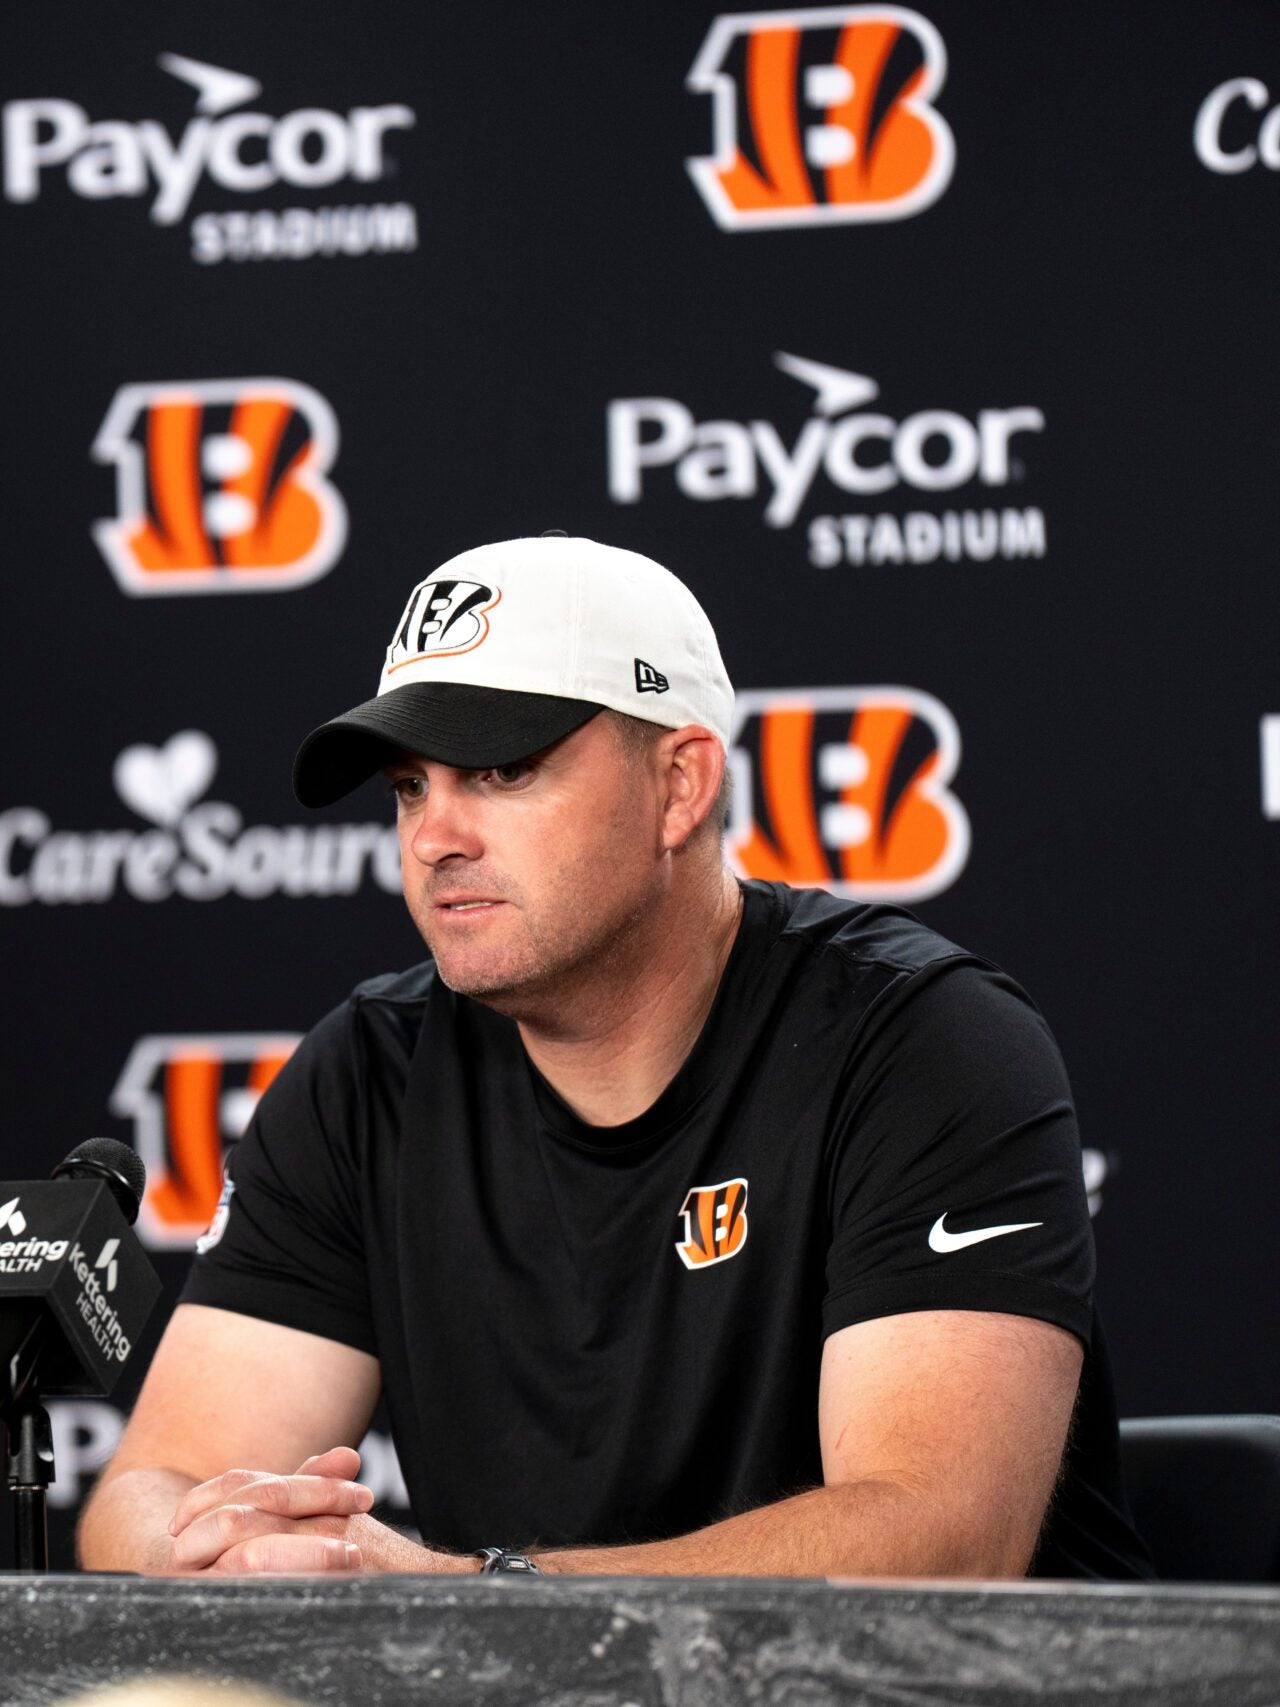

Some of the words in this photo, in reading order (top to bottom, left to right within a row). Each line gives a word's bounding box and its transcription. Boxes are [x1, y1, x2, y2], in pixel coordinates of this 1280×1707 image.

[2, 97, 415, 228] Paycor
[191, 203, 417, 263] STADIUM
[607, 400, 1045, 526] Paycor
[808, 508, 1046, 567] STADIUM
[69, 1242, 131, 1362] Kettering
[76, 1291, 116, 1361] HEALTH
